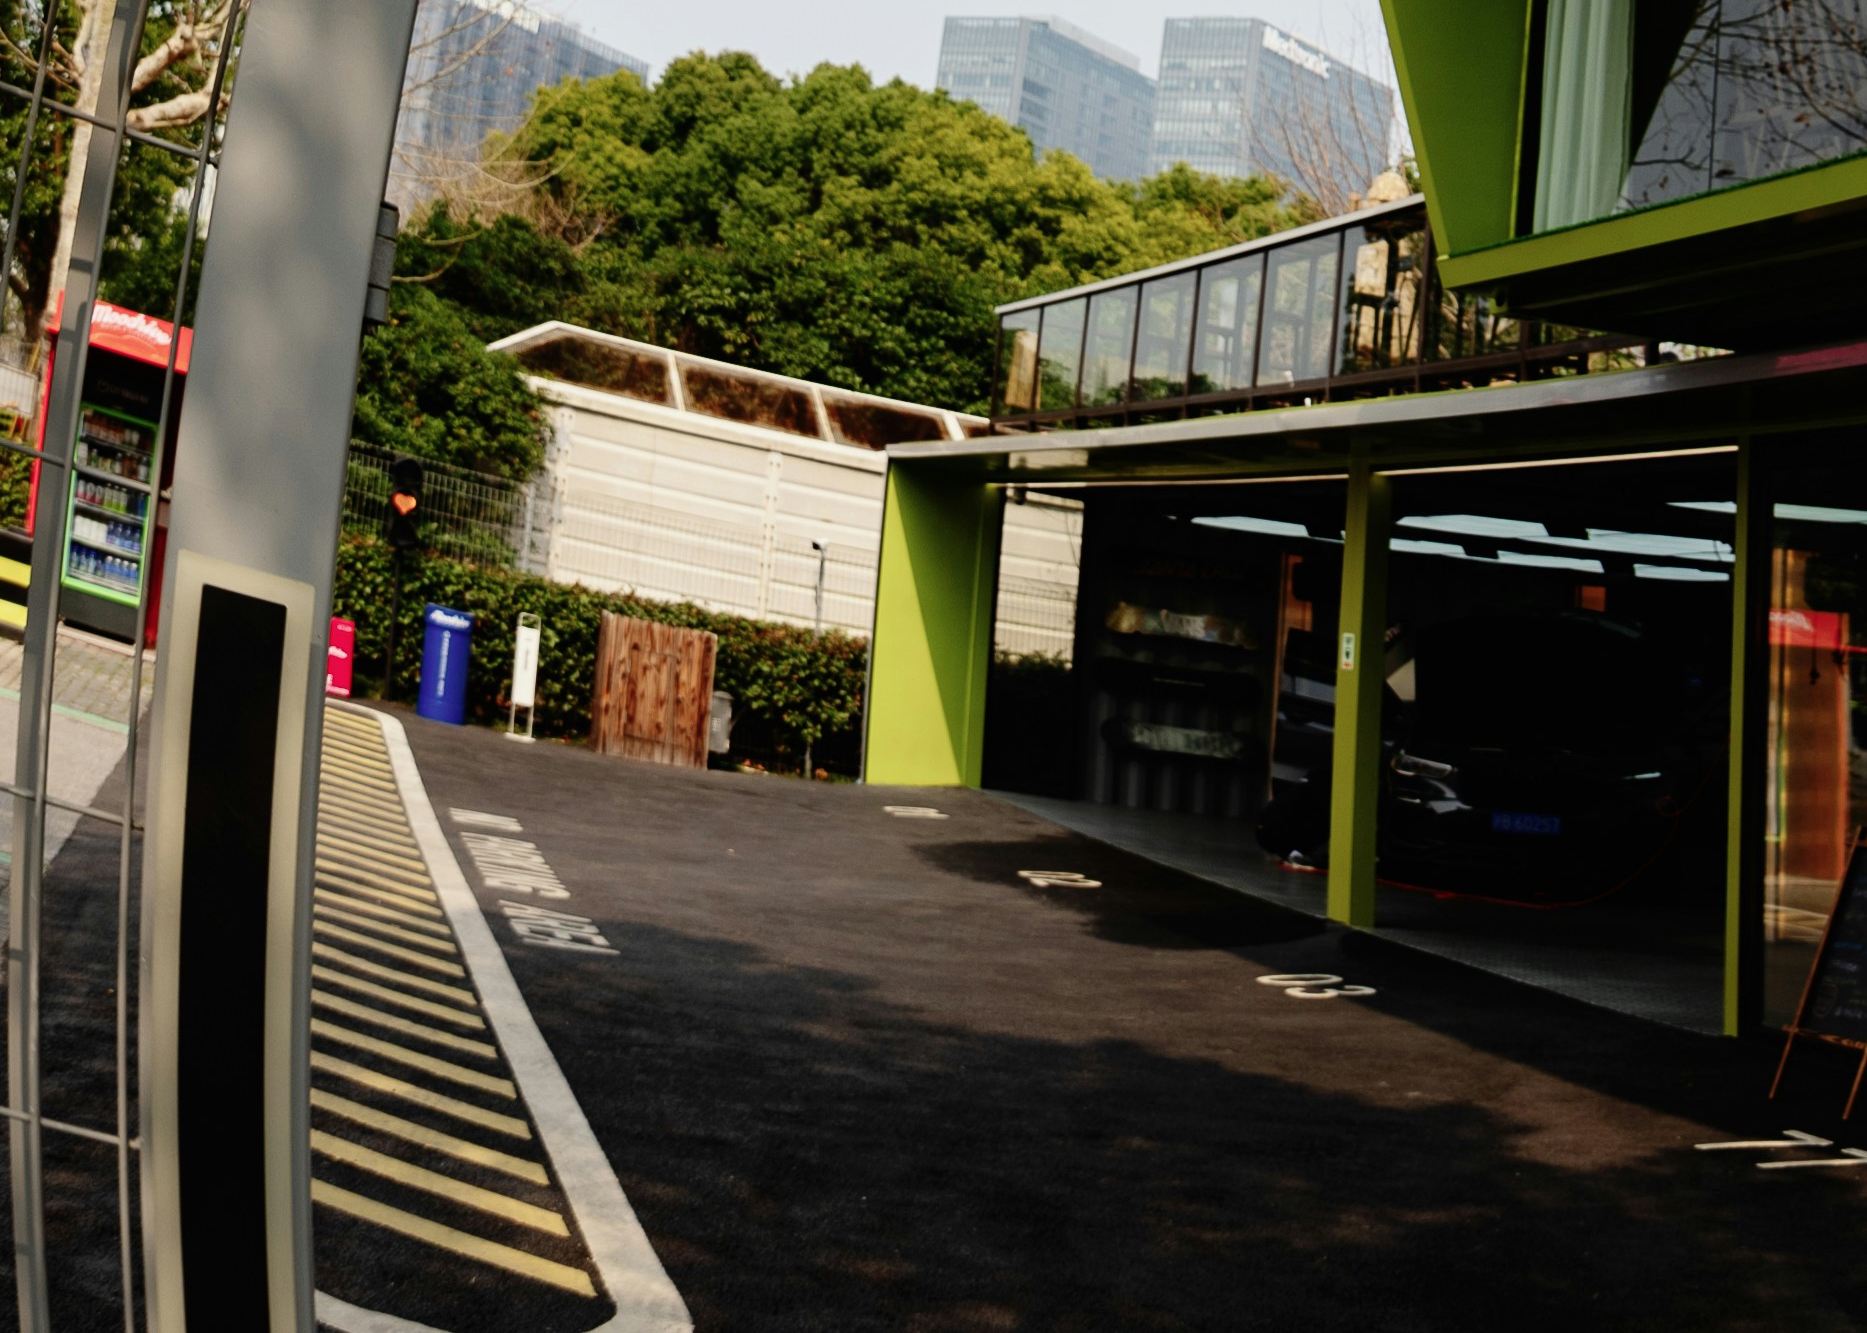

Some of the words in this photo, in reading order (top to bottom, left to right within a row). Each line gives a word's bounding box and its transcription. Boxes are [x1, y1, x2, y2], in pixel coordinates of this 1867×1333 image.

[1262, 25, 1330, 79] Medtronic
[498, 898, 621, 957] AREA
[1255, 972, 1378, 1000] 03
